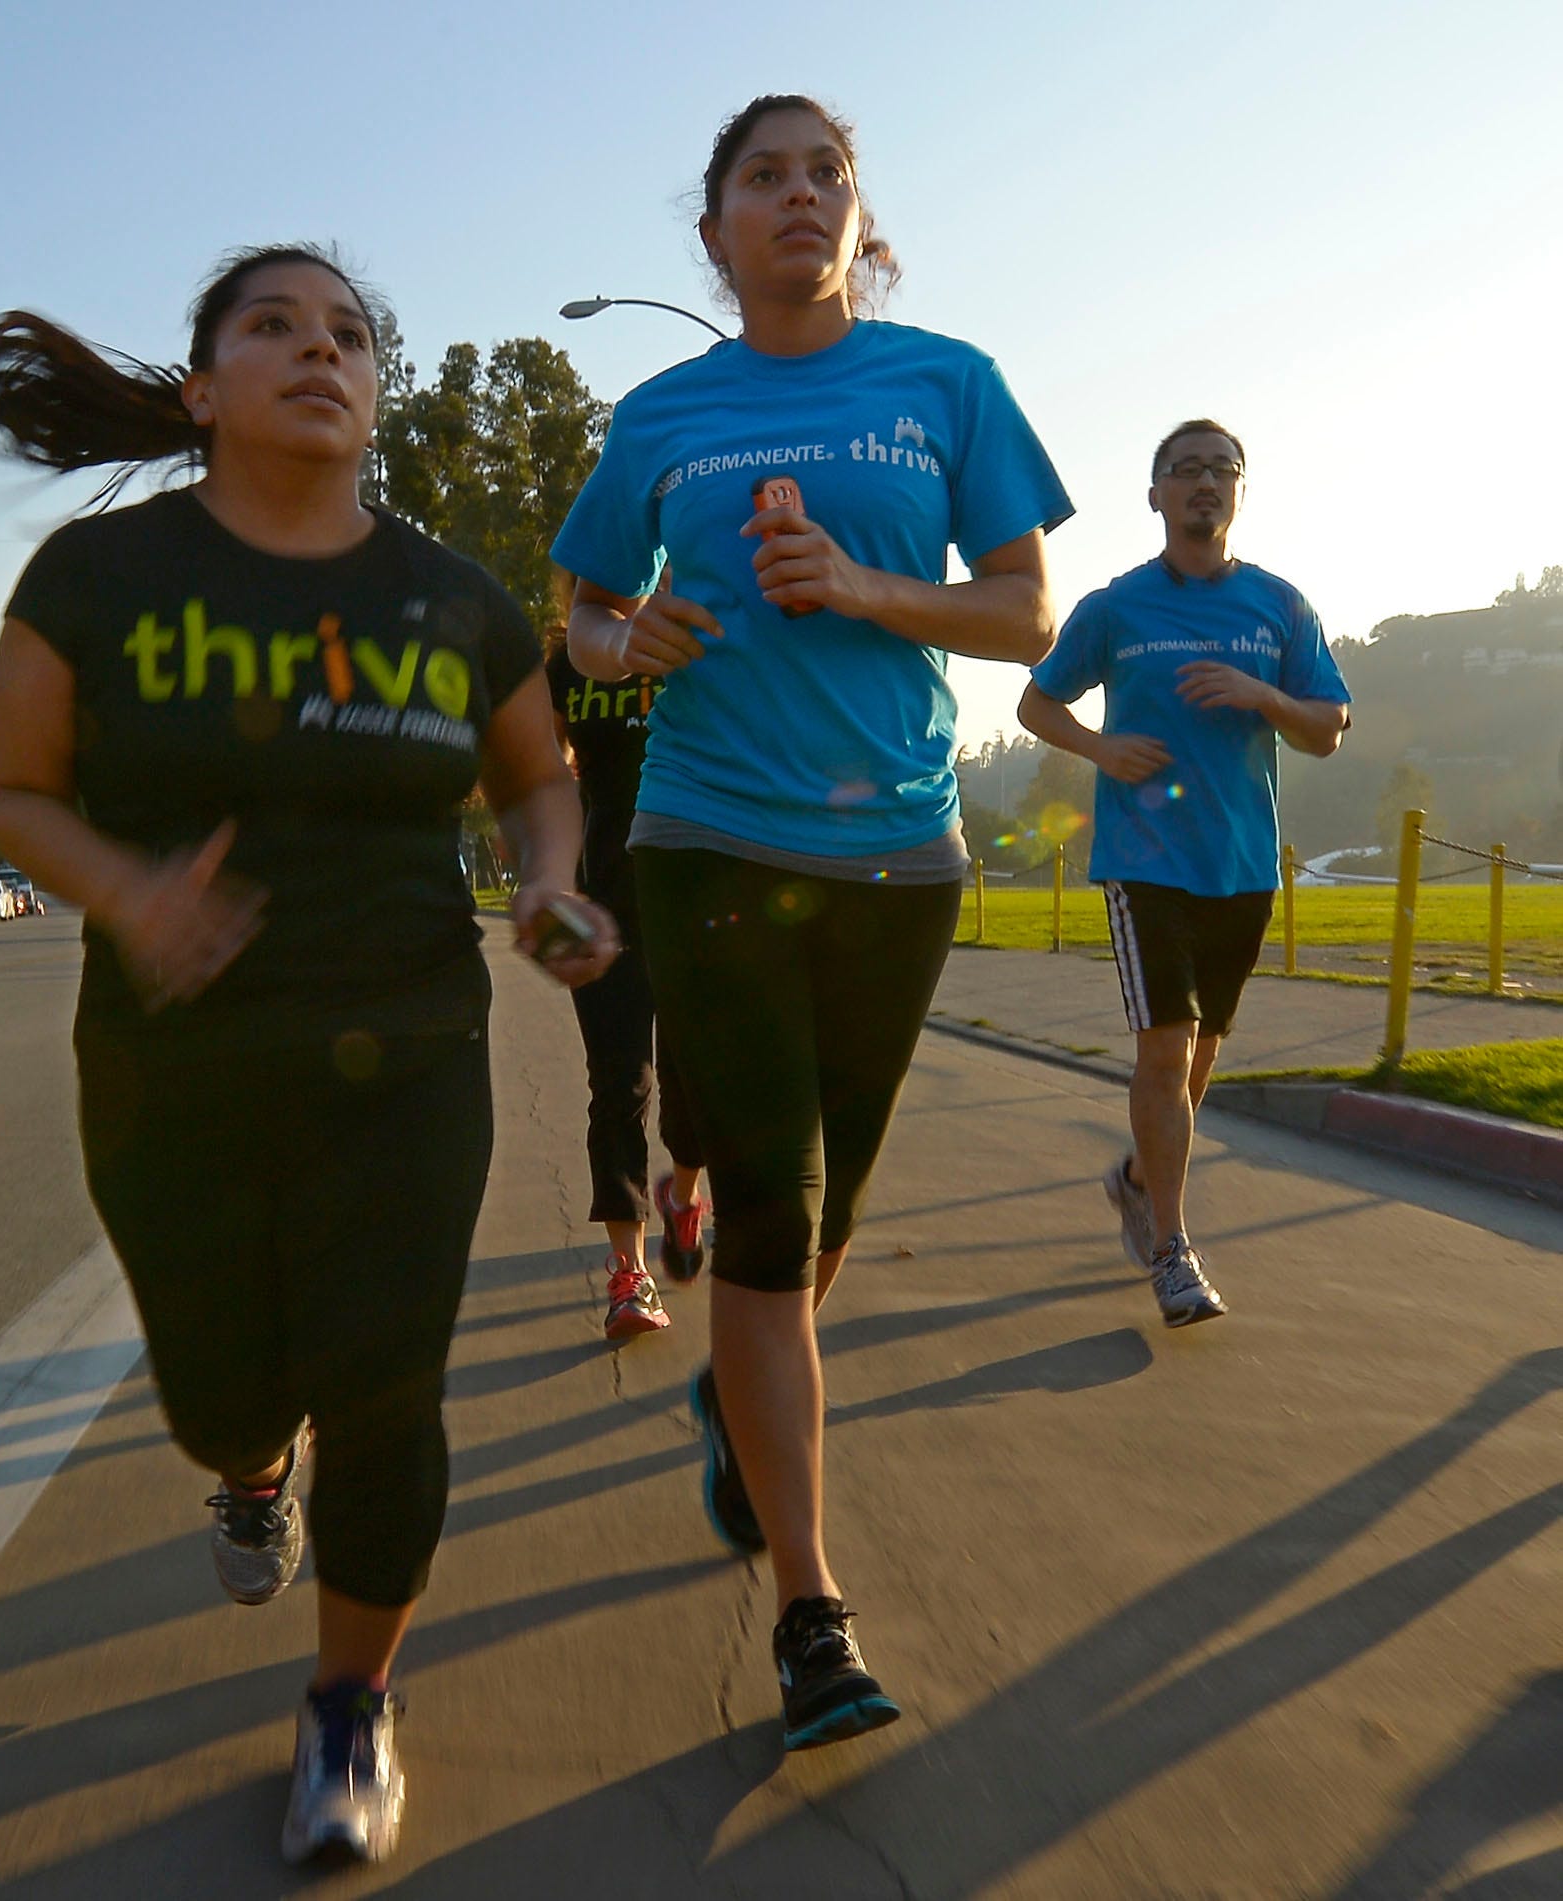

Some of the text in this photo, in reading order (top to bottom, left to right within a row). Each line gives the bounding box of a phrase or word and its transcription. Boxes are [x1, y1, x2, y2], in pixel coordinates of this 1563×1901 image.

[686, 444, 825, 480] PERMANENTE
[849, 432, 940, 476] thrive
[123, 598, 471, 720] thrive
[566, 677, 663, 723] thri
